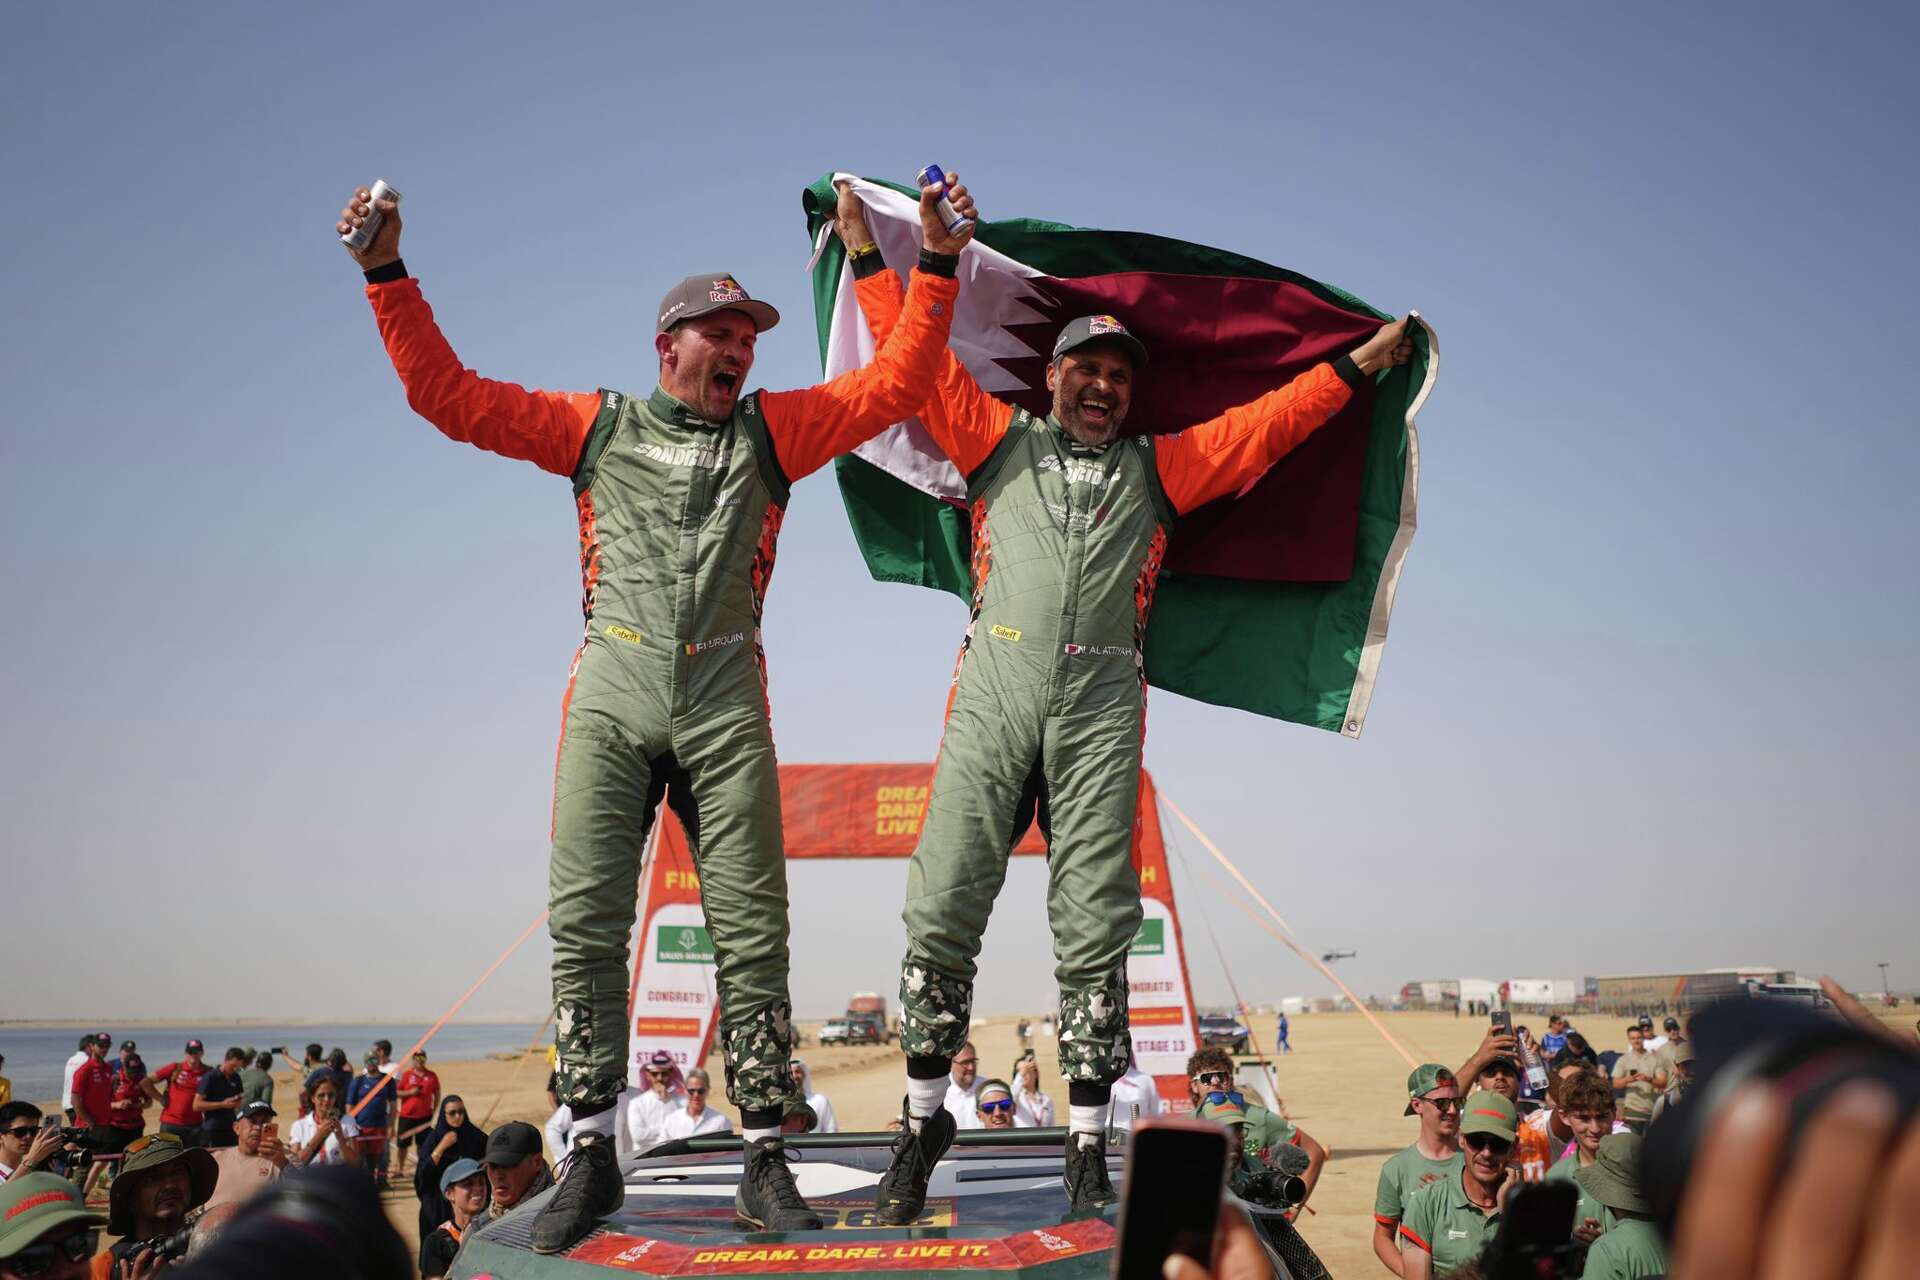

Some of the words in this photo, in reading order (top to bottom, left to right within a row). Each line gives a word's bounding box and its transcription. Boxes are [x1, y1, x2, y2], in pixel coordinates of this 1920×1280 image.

[877, 786, 929, 801] DREA
[664, 871, 701, 890] FIN
[648, 990, 706, 1004] CONGRATS!
[1136, 1040, 1169, 1053] STAGE
[1172, 1040, 1185, 1052] 13
[693, 1248, 800, 1265] DREAM.
[805, 1246, 888, 1261] DARE.
[893, 1245, 954, 1259] LIVE
[958, 1244, 991, 1258] IT.
